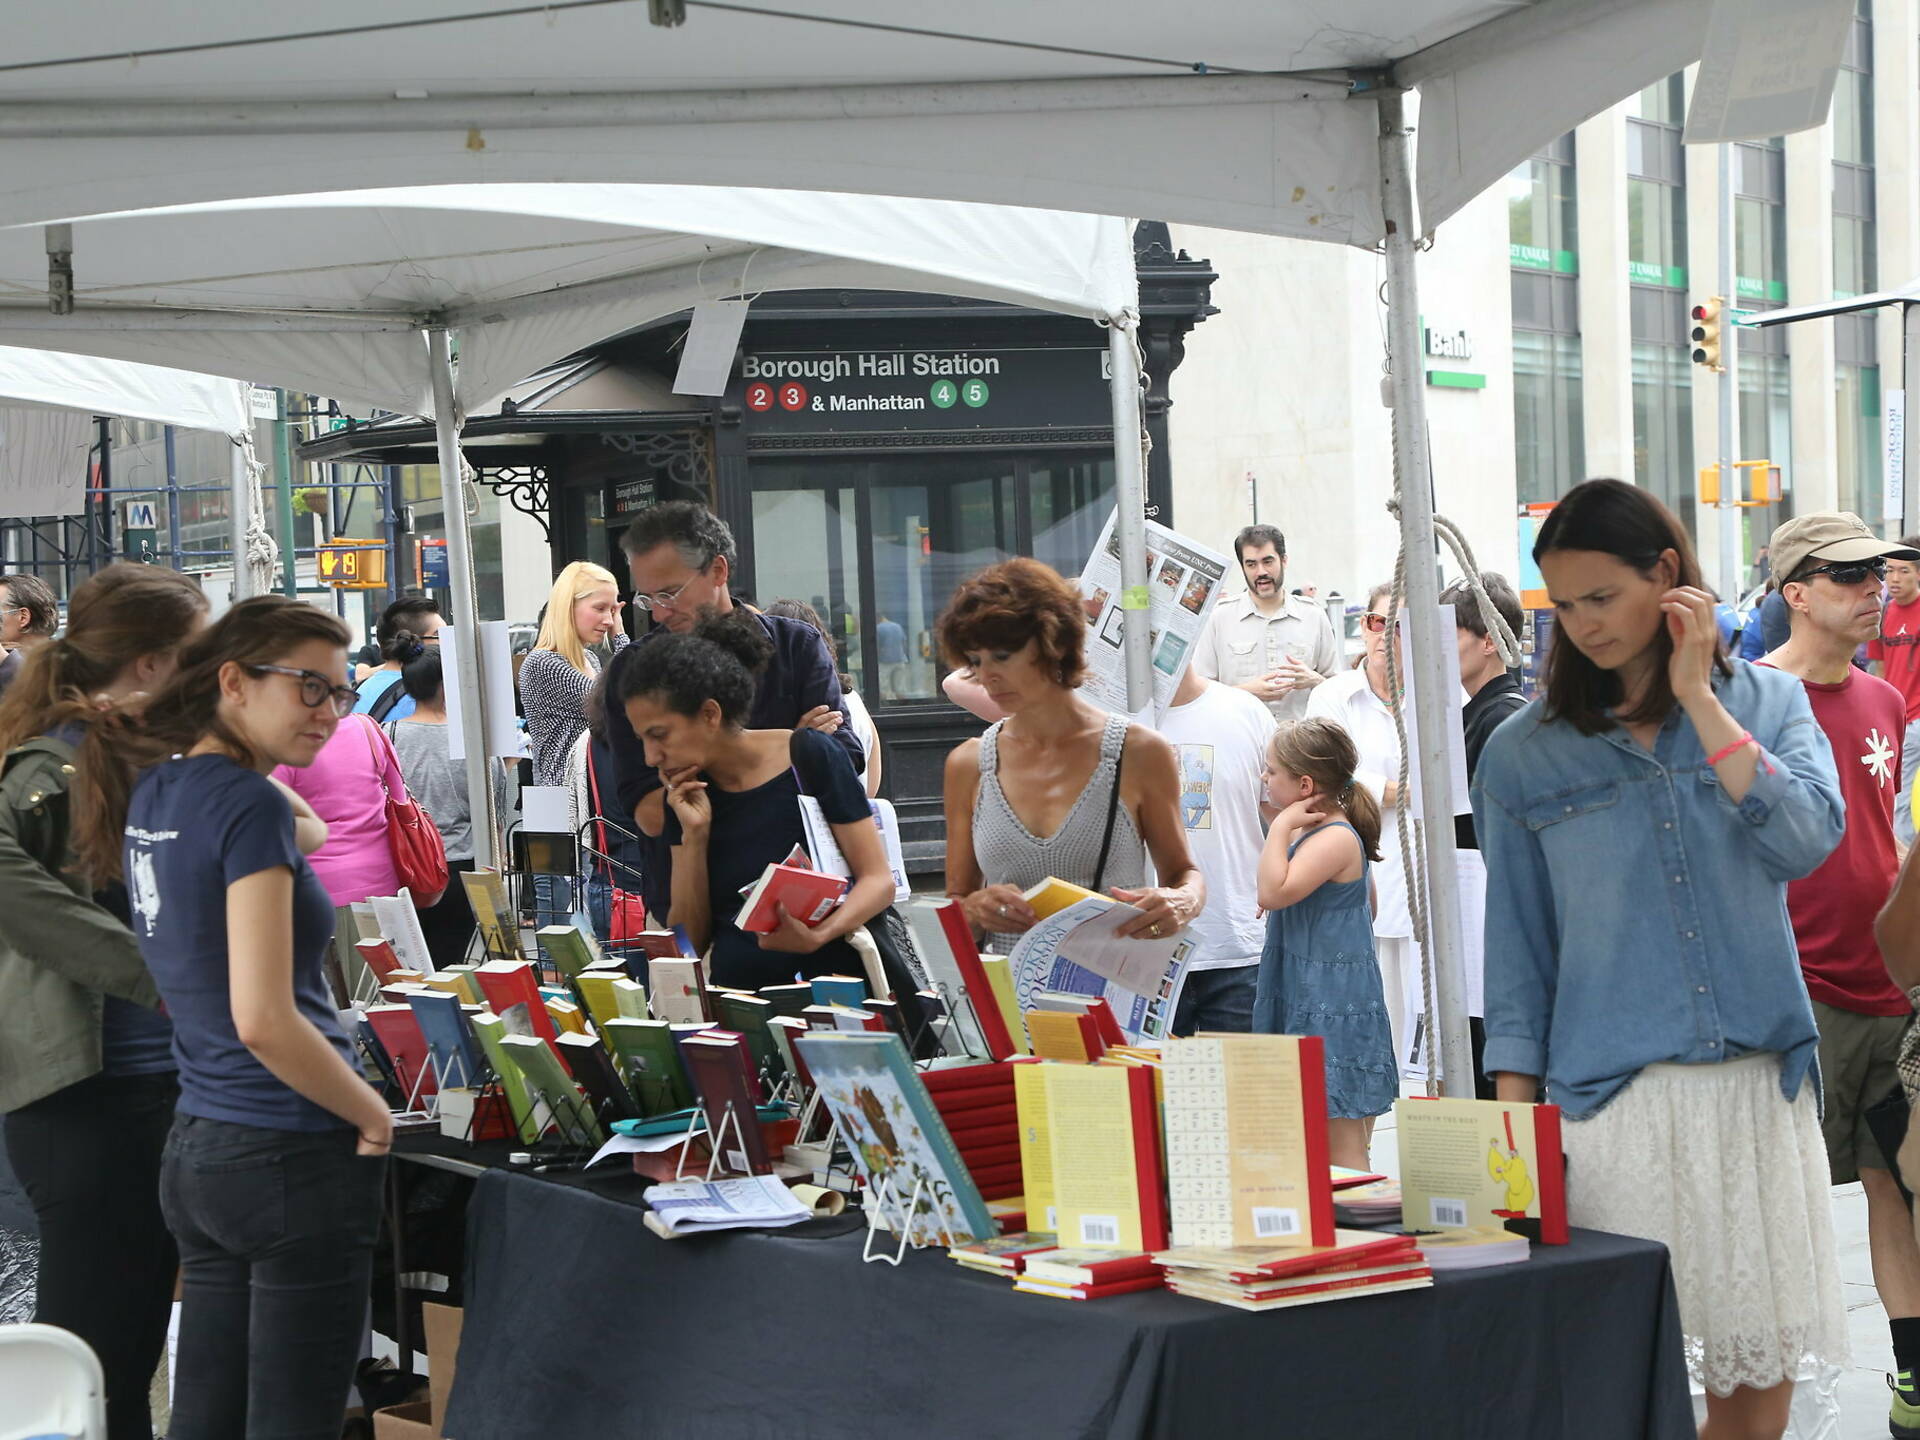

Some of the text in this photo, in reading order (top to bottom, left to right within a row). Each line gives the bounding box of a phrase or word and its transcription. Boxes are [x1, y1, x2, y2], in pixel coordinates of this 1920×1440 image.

[742, 352, 1000, 383] Borough Hall Station
[753, 384, 982, 412] 2 3 & Manhattan 4 5
